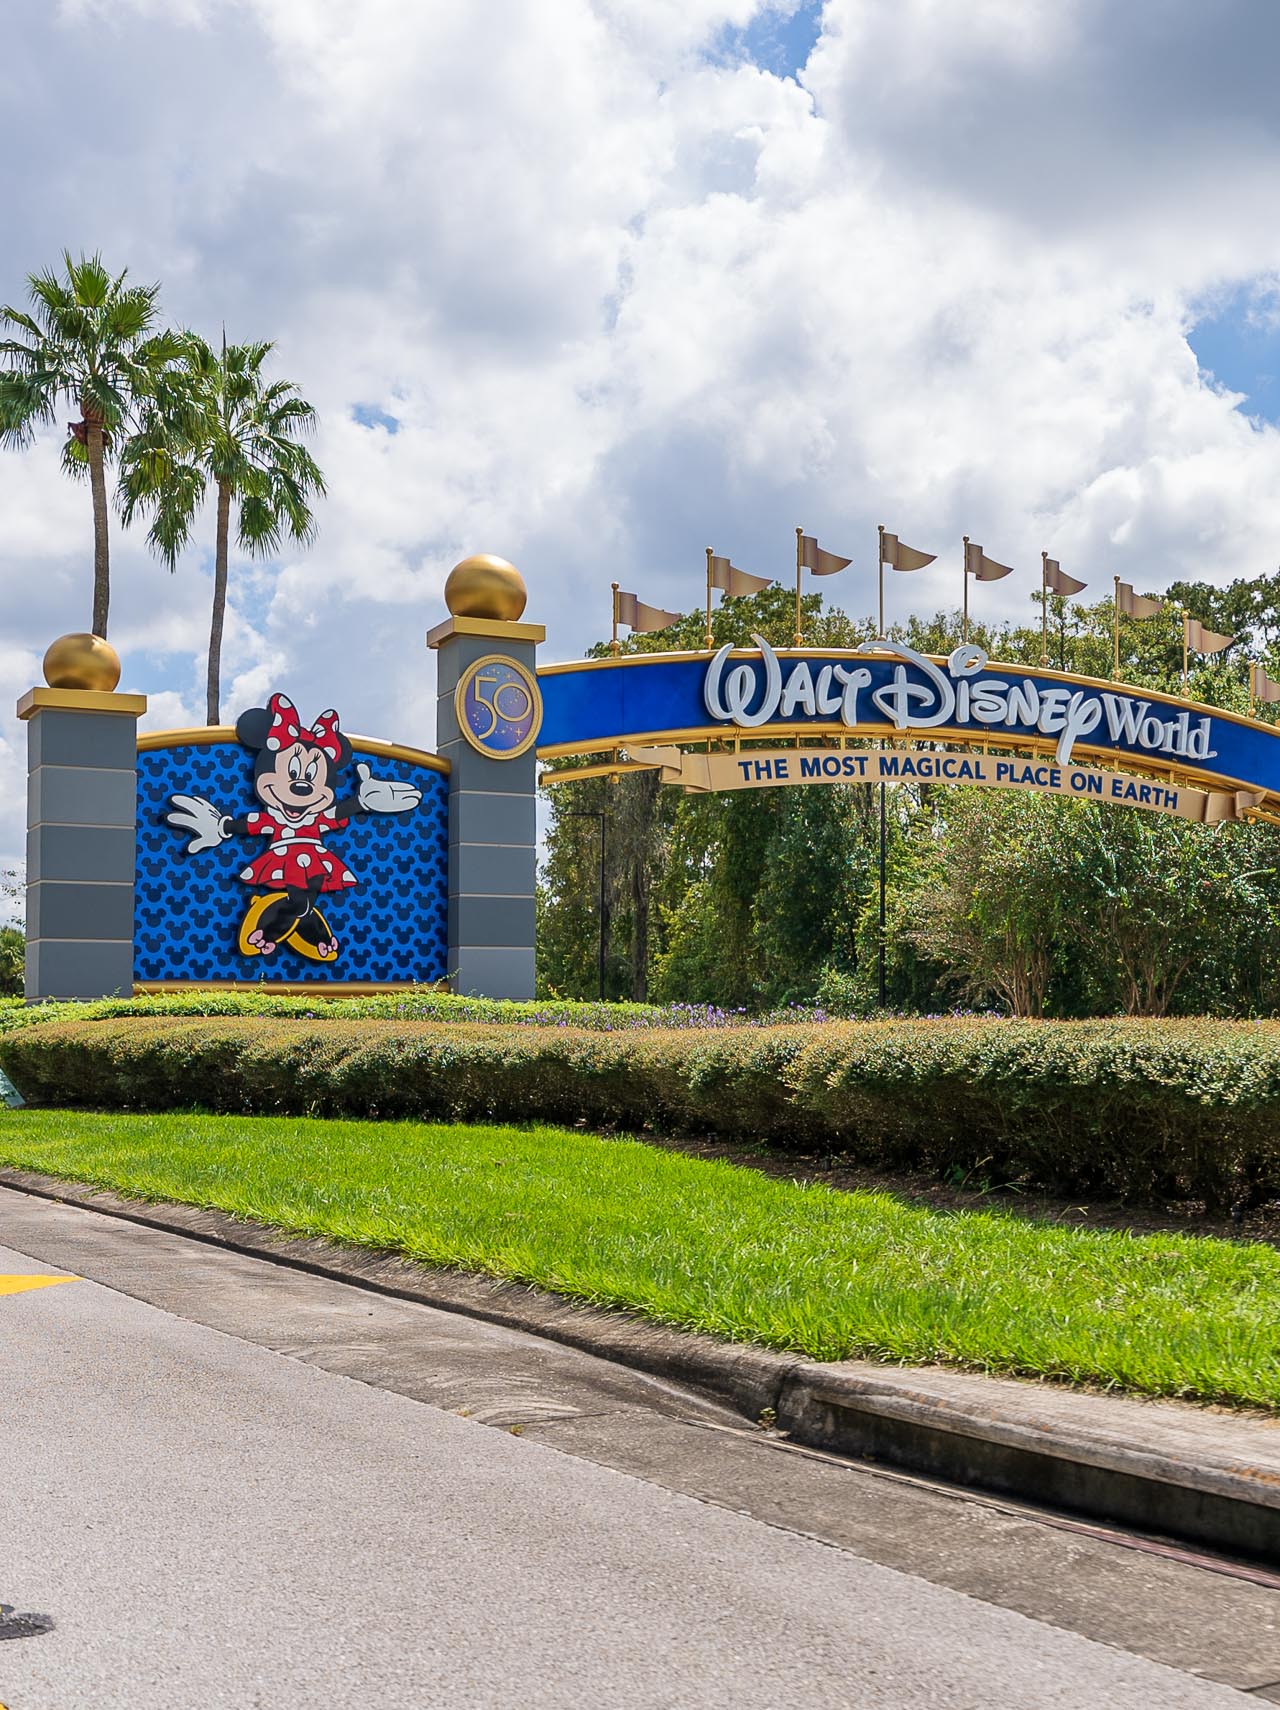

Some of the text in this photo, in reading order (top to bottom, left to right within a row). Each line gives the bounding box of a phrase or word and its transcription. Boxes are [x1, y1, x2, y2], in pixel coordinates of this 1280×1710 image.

[474, 676, 532, 740] 50
[1101, 692, 1217, 760] World
[738, 755, 1178, 809] THE MOST MAGICAL PLACE ON EARTH
